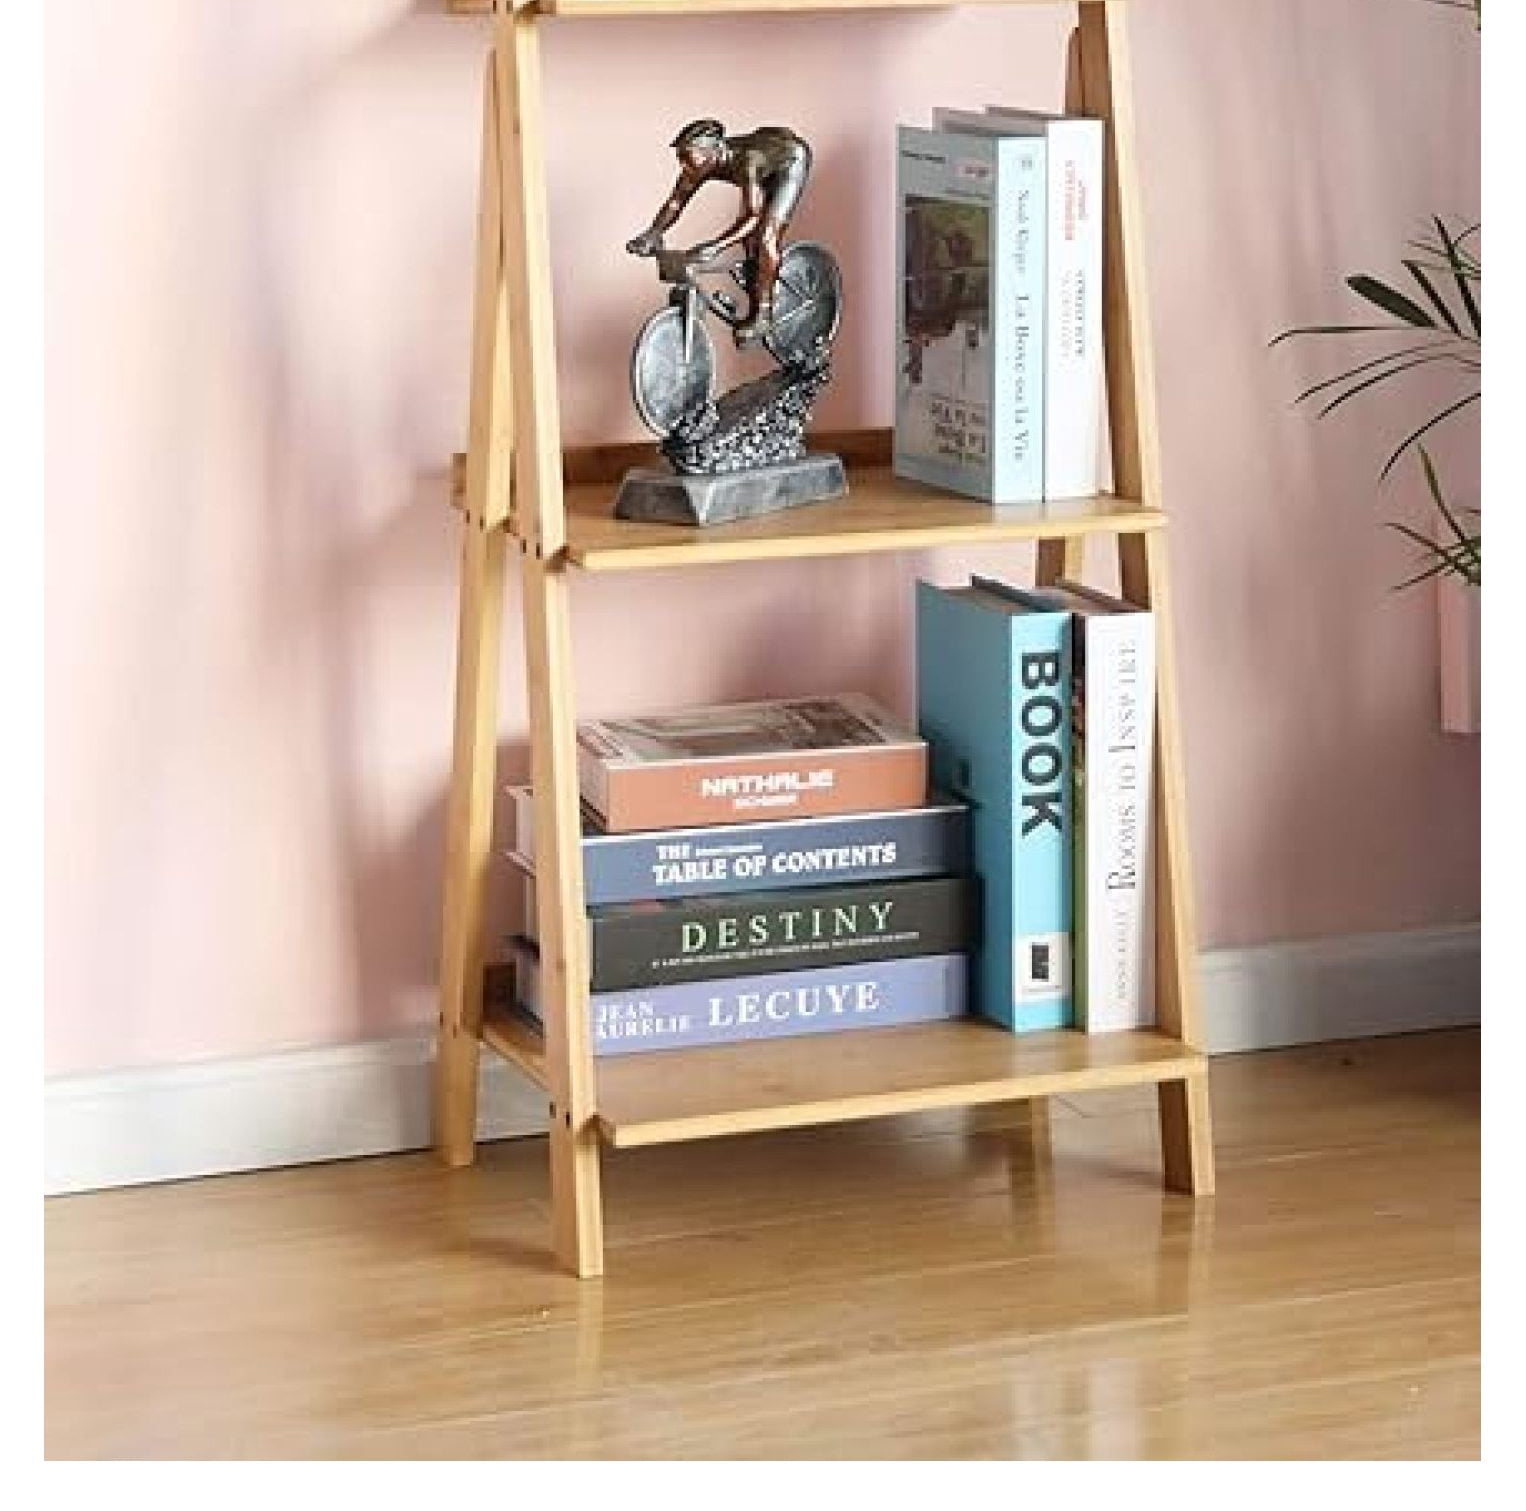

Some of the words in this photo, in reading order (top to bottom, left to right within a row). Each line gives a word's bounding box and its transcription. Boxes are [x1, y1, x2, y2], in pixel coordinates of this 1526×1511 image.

[1020, 652, 1063, 838] BOOK
[701, 769, 833, 799] NATHALIE
[652, 859, 727, 885] TABLE
[735, 856, 766, 878] OF
[772, 842, 897, 873] CONTENTS
[656, 844, 691, 861] THE
[681, 901, 893, 954] DESTINY
[597, 1001, 655, 1023] JEAN
[709, 981, 879, 1027] LECUYE
